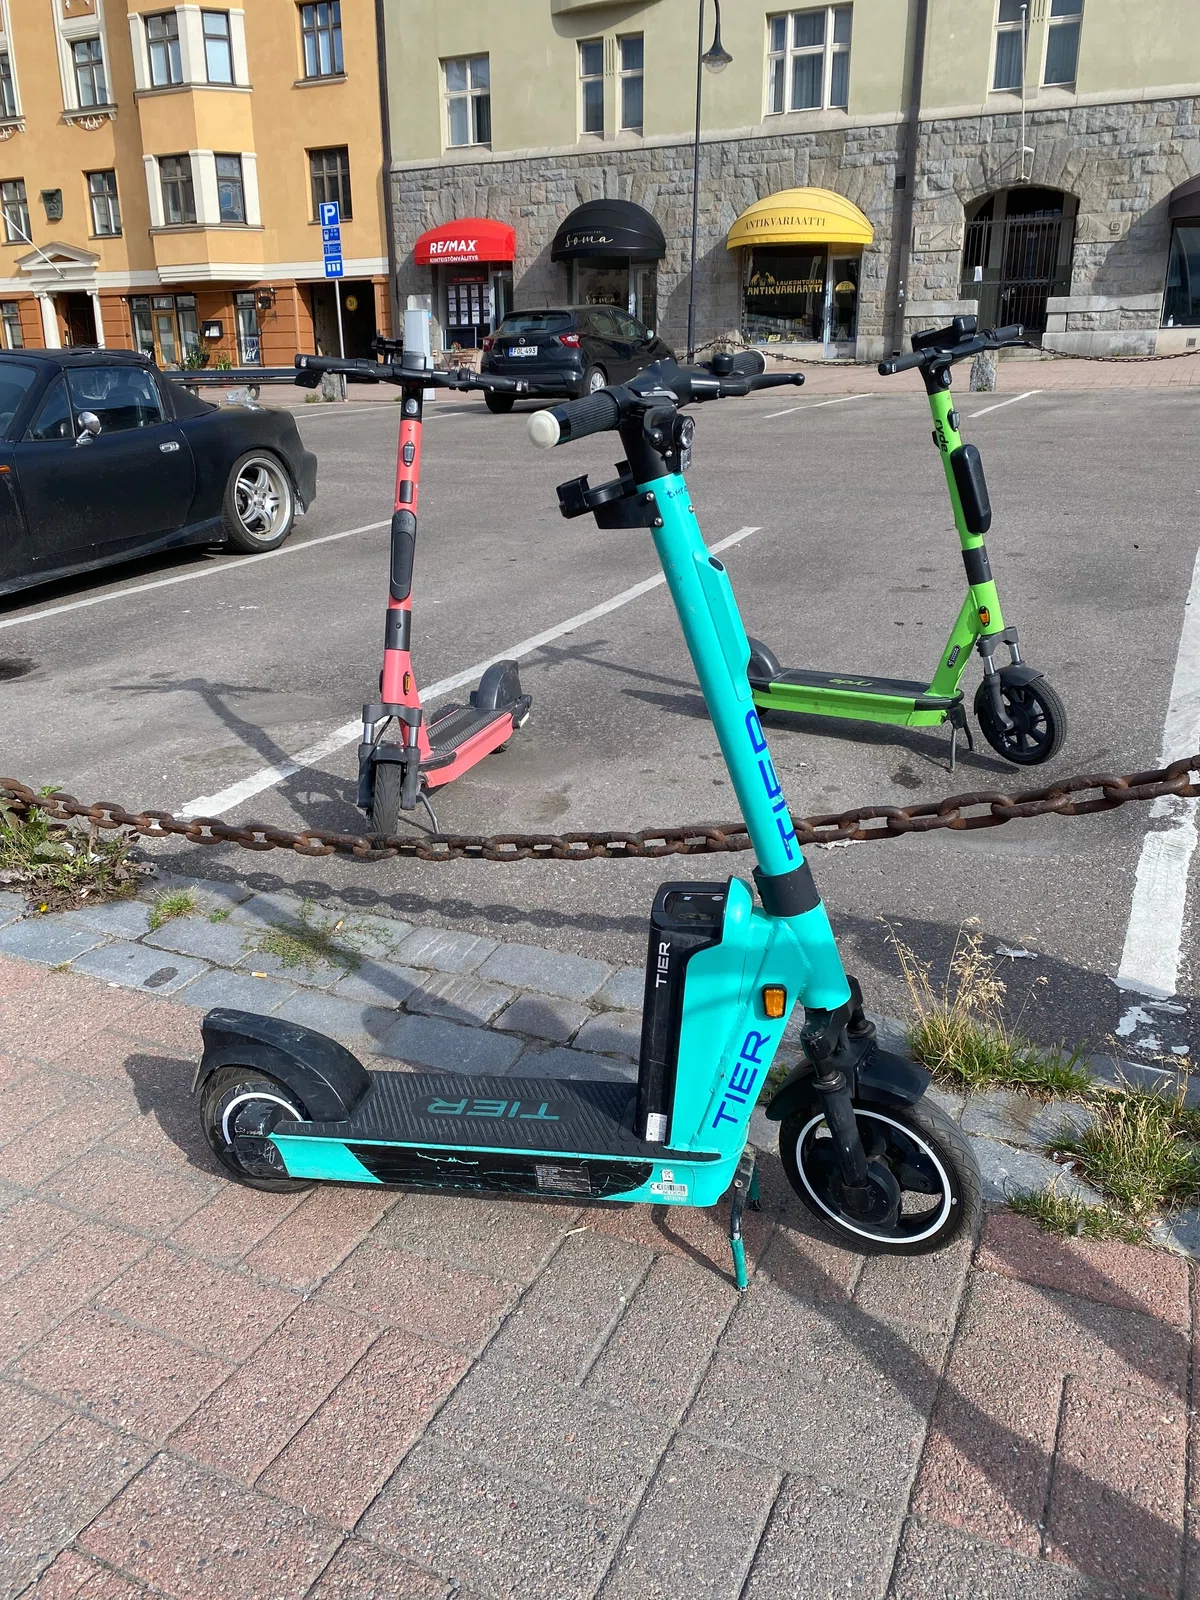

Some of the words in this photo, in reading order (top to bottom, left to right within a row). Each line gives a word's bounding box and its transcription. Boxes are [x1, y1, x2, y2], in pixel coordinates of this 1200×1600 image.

[323, 204, 336, 225] P
[745, 216, 826, 230] ANTIKVARIAATTI
[429, 239, 477, 254] RE/MAX
[747, 284, 823, 296] ANTIKVARIAATTI
[935, 418, 949, 453] ryde
[655, 941, 671, 988] TIER
[711, 1030, 772, 1129] TIER
[425, 1096, 561, 1121] TIER
